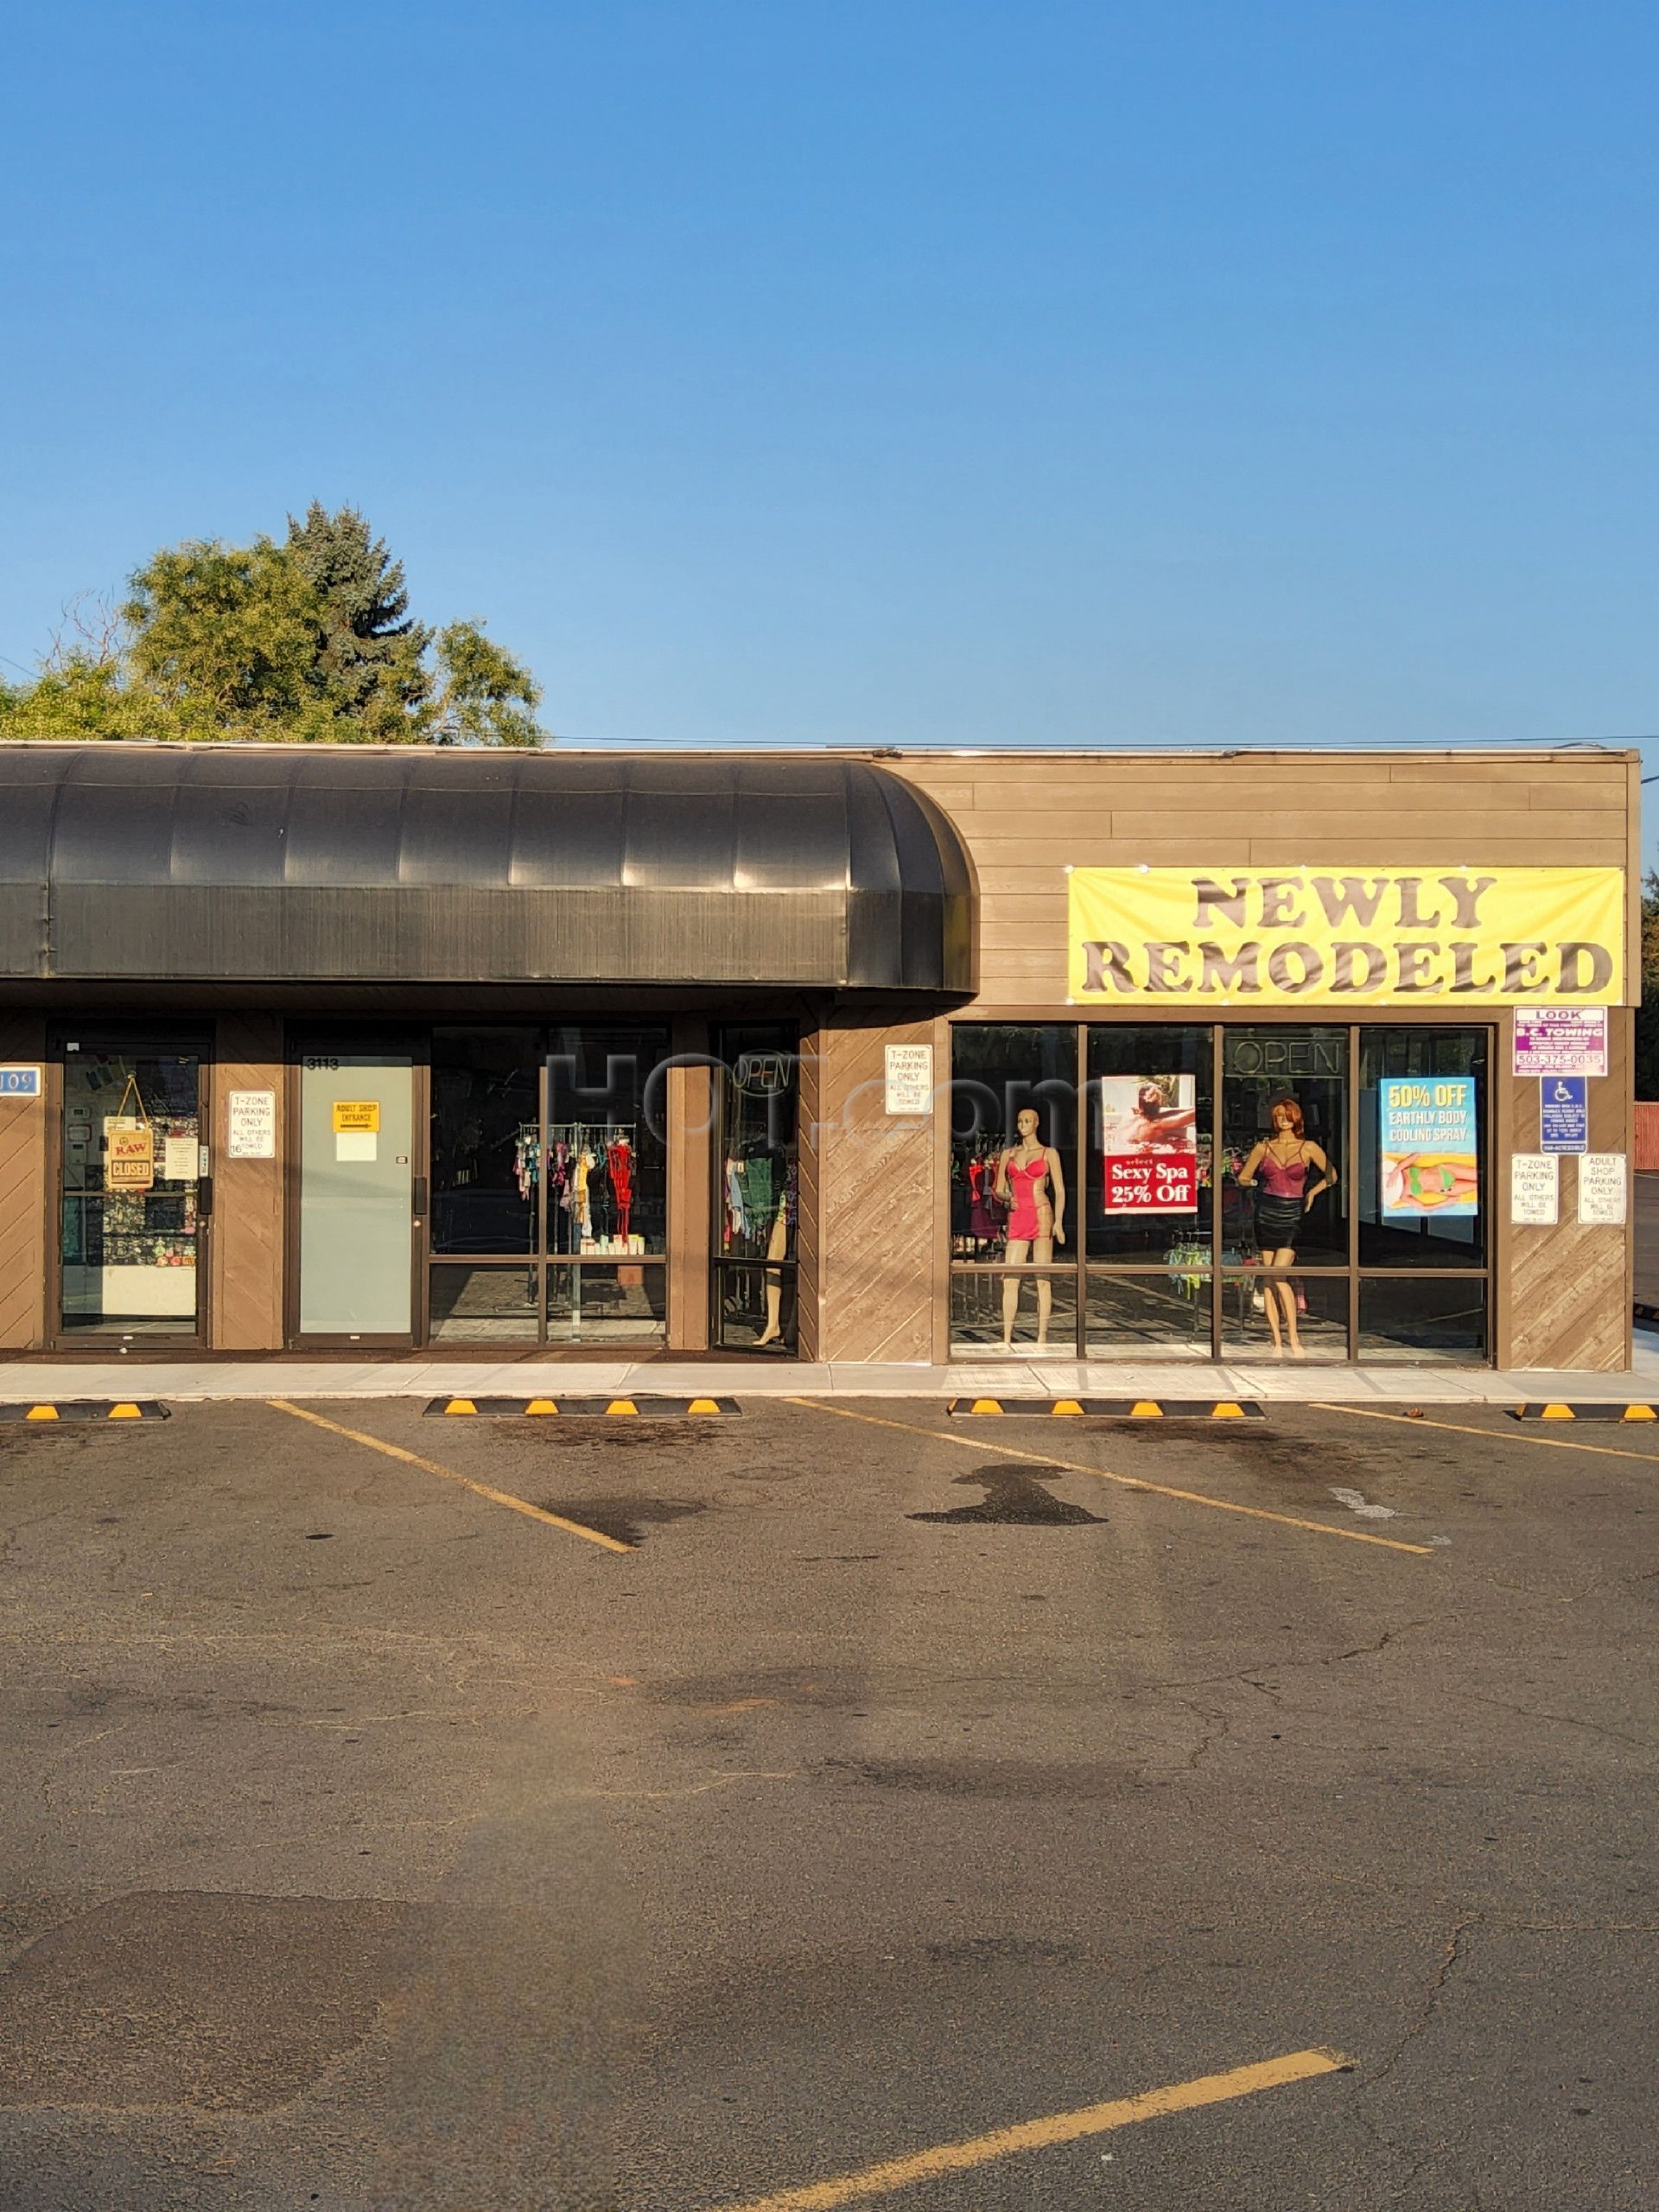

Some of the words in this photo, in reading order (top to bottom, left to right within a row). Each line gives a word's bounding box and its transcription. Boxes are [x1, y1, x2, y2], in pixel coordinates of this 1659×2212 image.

[1191, 876, 1498, 929] NEWLY
[1081, 940, 1613, 994] REMODELED
[1535, 1010, 1583, 1020] LOOK
[1544, 1027, 1604, 1037] TOWING
[891, 1050, 927, 1059] T-ZONE
[1234, 1041, 1339, 1074] OPEN
[307, 1058, 339, 1071] 3113
[890, 1061, 929, 1071] PARKING
[732, 1057, 791, 1089] OPEN
[234, 1096, 270, 1105] T-ZONE
[1389, 1085, 1431, 1107] 50%
[1434, 1084, 1468, 1106] OFF
[233, 1107, 270, 1116] PARKING
[1389, 1110, 1436, 1125] EARTHLY
[1438, 1110, 1468, 1123] BODY
[240, 1118, 263, 1127] ONLY
[1433, 1128, 1467, 1141] SPRAY
[115, 1142, 147, 1155] RAW
[112, 1162, 149, 1176] CLOSED
[1516, 1160, 1553, 1169] T-ZONE
[1112, 1164, 1153, 1184] Sexy
[1155, 1163, 1188, 1184] Spa
[1514, 1172, 1554, 1180] PARKING
[1583, 1177, 1622, 1185] PARKING
[1111, 1185, 1152, 1203] 25%
[1156, 1185, 1192, 1202] Off
